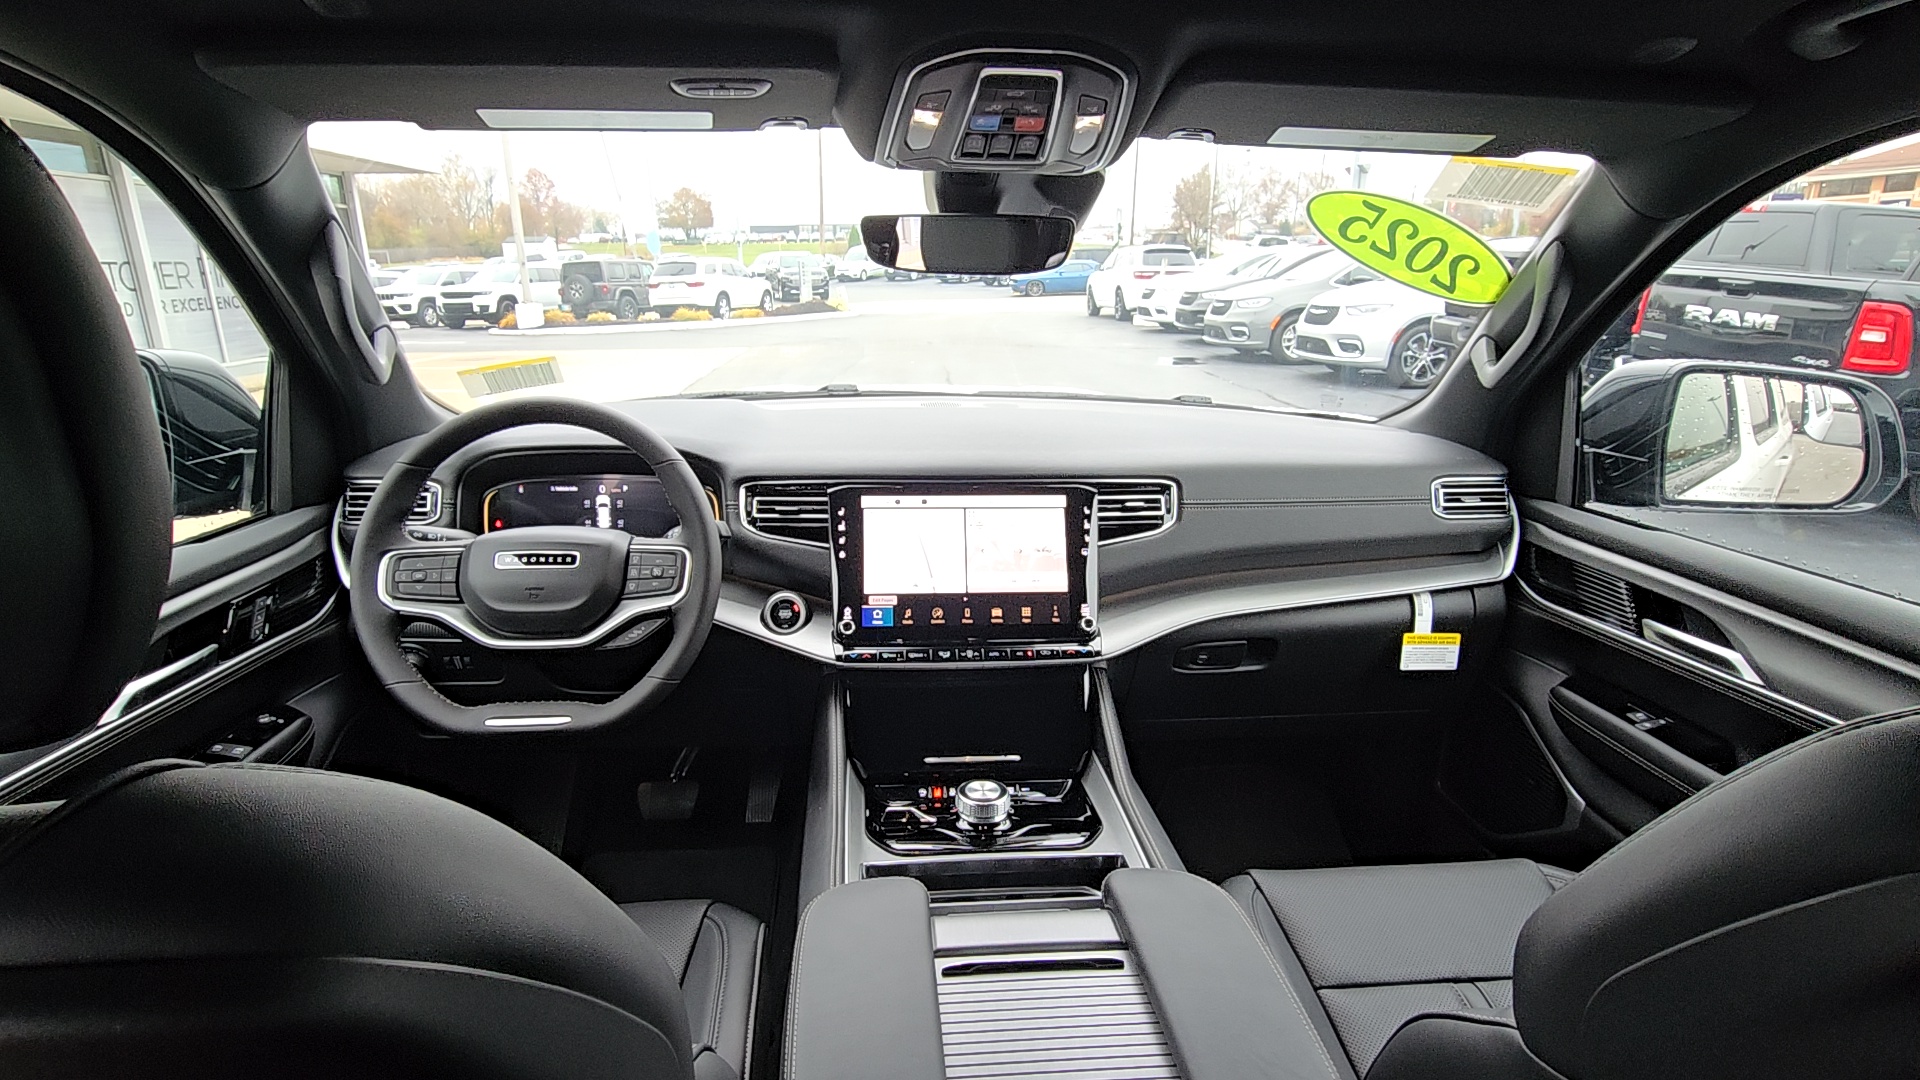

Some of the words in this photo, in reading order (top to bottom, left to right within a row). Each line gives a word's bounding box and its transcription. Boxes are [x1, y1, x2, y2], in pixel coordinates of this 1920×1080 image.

[171, 296, 242, 313] EXCELENC
[1683, 304, 1780, 332] RAM
[504, 556, 573, 564] WAGONEER
